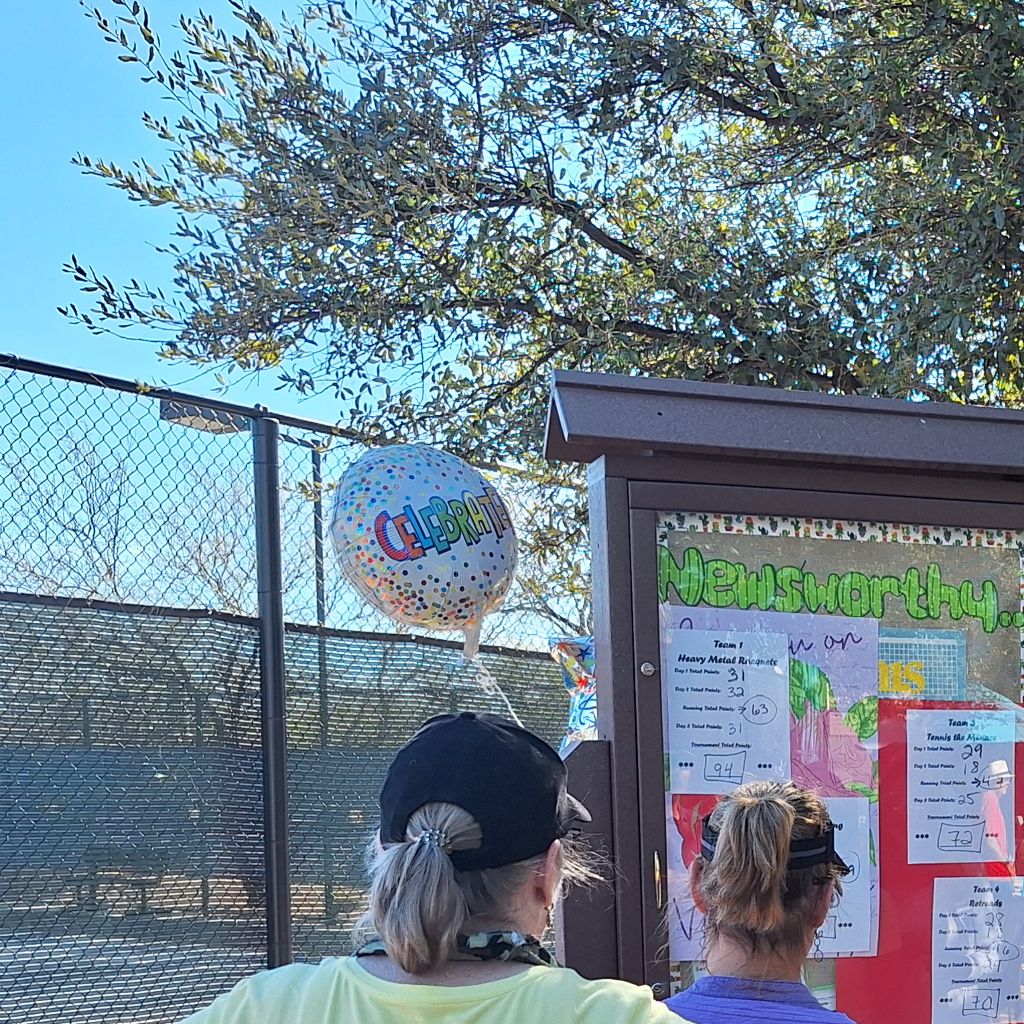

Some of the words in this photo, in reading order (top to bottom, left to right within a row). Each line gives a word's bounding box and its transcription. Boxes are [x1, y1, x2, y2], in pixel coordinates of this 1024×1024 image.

[374, 487, 512, 561] CELEBRATE
[713, 640, 736, 649] Team
[678, 654, 706, 664] Heavy
[708, 655, 736, 664] Metal
[738, 656, 778, 667] Racquets
[728, 667, 745, 682] 31
[728, 687, 744, 698] 32
[751, 704, 769, 715] 63
[729, 722, 742, 735] 31
[948, 719, 968, 727] Team
[927, 733, 951, 741] Tennis
[953, 733, 965, 741] the
[962, 744, 982, 760] 29
[714, 763, 733, 778] 94
[964, 761, 979, 775] 18
[958, 792, 981, 805] 25
[948, 831, 973, 847] 72
[984, 912, 1004, 927] 28
[971, 996, 992, 1010] 70
